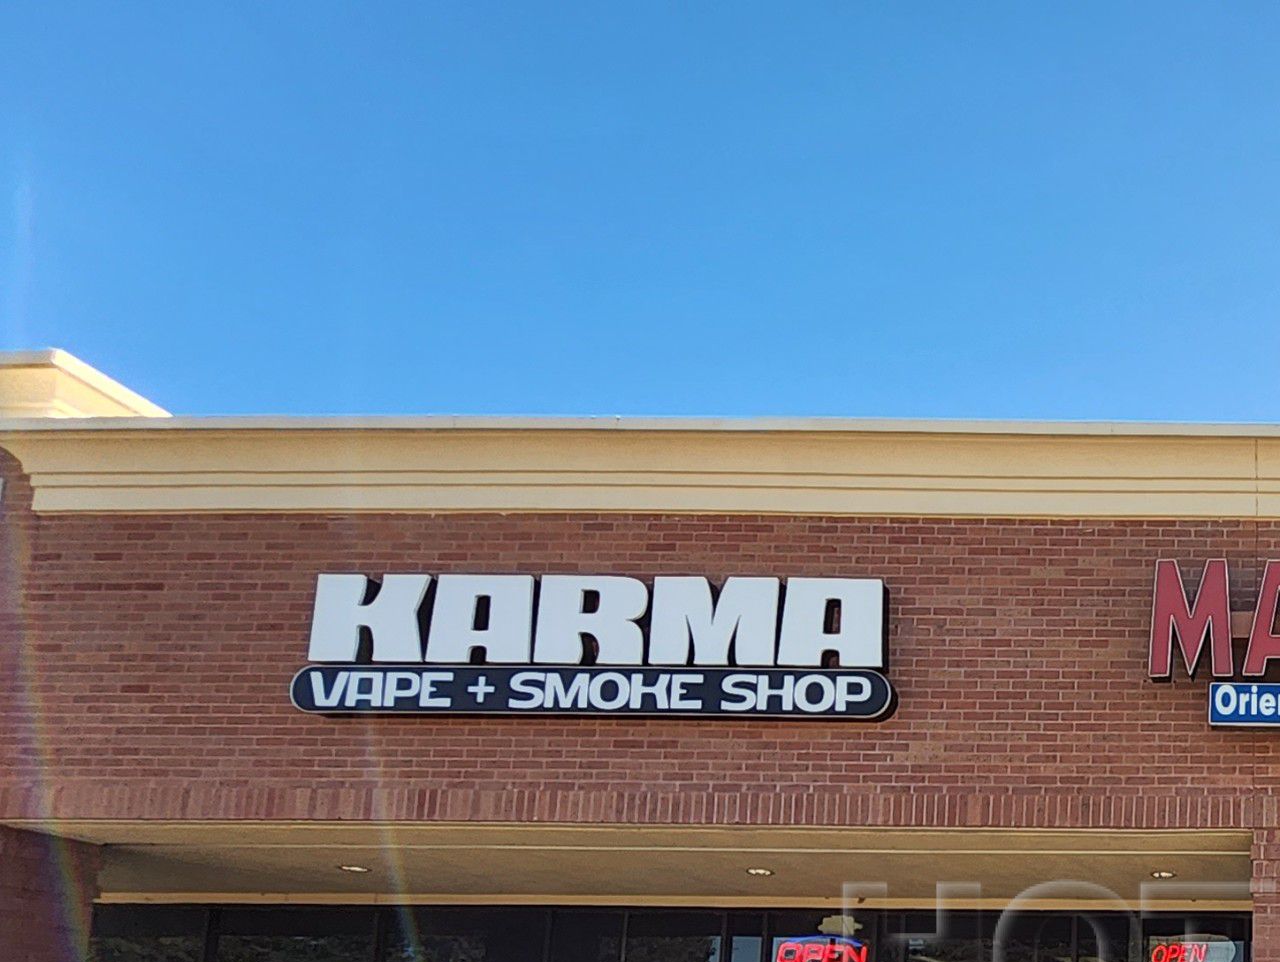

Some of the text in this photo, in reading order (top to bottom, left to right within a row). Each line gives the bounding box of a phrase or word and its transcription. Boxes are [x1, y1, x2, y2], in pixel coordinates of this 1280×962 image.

[308, 574, 884, 667] KARMA
[309, 672, 873, 712] VAPE + SMOKE SHOP
